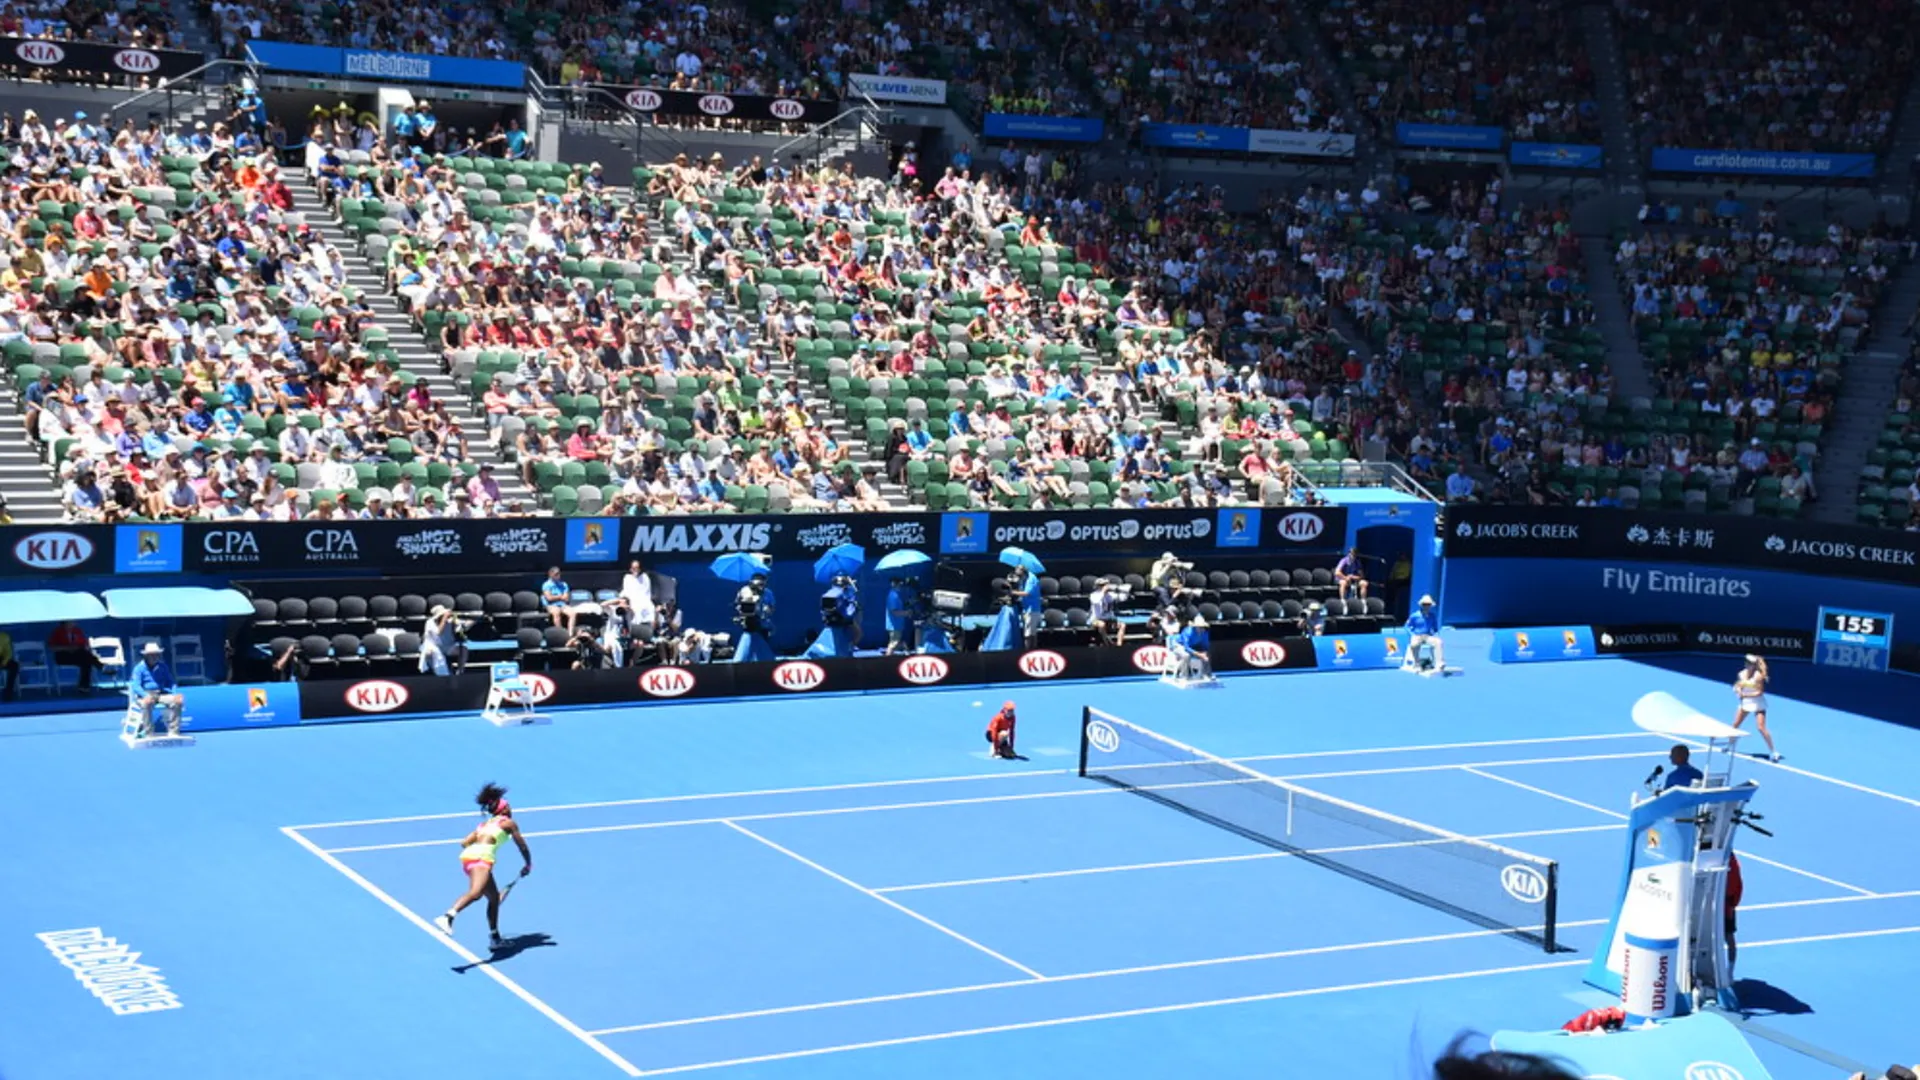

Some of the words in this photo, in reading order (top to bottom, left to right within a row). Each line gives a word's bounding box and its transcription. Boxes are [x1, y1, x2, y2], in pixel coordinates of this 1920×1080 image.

[24, 45, 57, 60] KIA
[121, 54, 153, 68] KIA
[347, 53, 430, 77] MELBOURNE
[630, 93, 657, 107] KIA
[703, 99, 729, 111] KIA
[775, 103, 800, 116] KIA
[1694, 153, 1830, 170] cardiotennis.com.au
[509, 528, 541, 541] HOT
[995, 525, 1045, 542] OPTUS
[1071, 525, 1120, 541] OPTUS
[1144, 524, 1192, 540] OPTUS
[1285, 518, 1317, 535] KIA
[1474, 522, 1528, 538] JACOB'S
[1532, 523, 1579, 539] CREEK
[204, 531, 259, 553] CPA
[305, 529, 359, 552] CPA
[422, 529, 455, 542] HOT
[629, 522, 771, 553] MAXXIS
[1652, 526, 1715, 548] 杰卡斯
[26, 539, 81, 561] KIA
[204, 554, 260, 562] AUSTRALIA
[305, 552, 360, 561] AUSTRALIA
[1788, 538, 1856, 559] JACOB'S
[1860, 546, 1915, 566] CREEK
[1602, 567, 1641, 594] Fly
[1648, 570, 1751, 598] Emirates
[1835, 614, 1875, 634] 155
[1763, 636, 1803, 649] CREEK
[1249, 647, 1279, 662] KIA
[1824, 643, 1880, 670] IBM
[907, 662, 942, 680] KIA
[1026, 656, 1059, 672] KIA
[649, 673, 687, 691] KIA
[781, 668, 817, 686] KIA
[357, 687, 399, 706] KIA
[1508, 868, 1540, 898] KIA
[35, 926, 184, 1015] MELBOURNE
[1651, 955, 1668, 1012] Wilson
